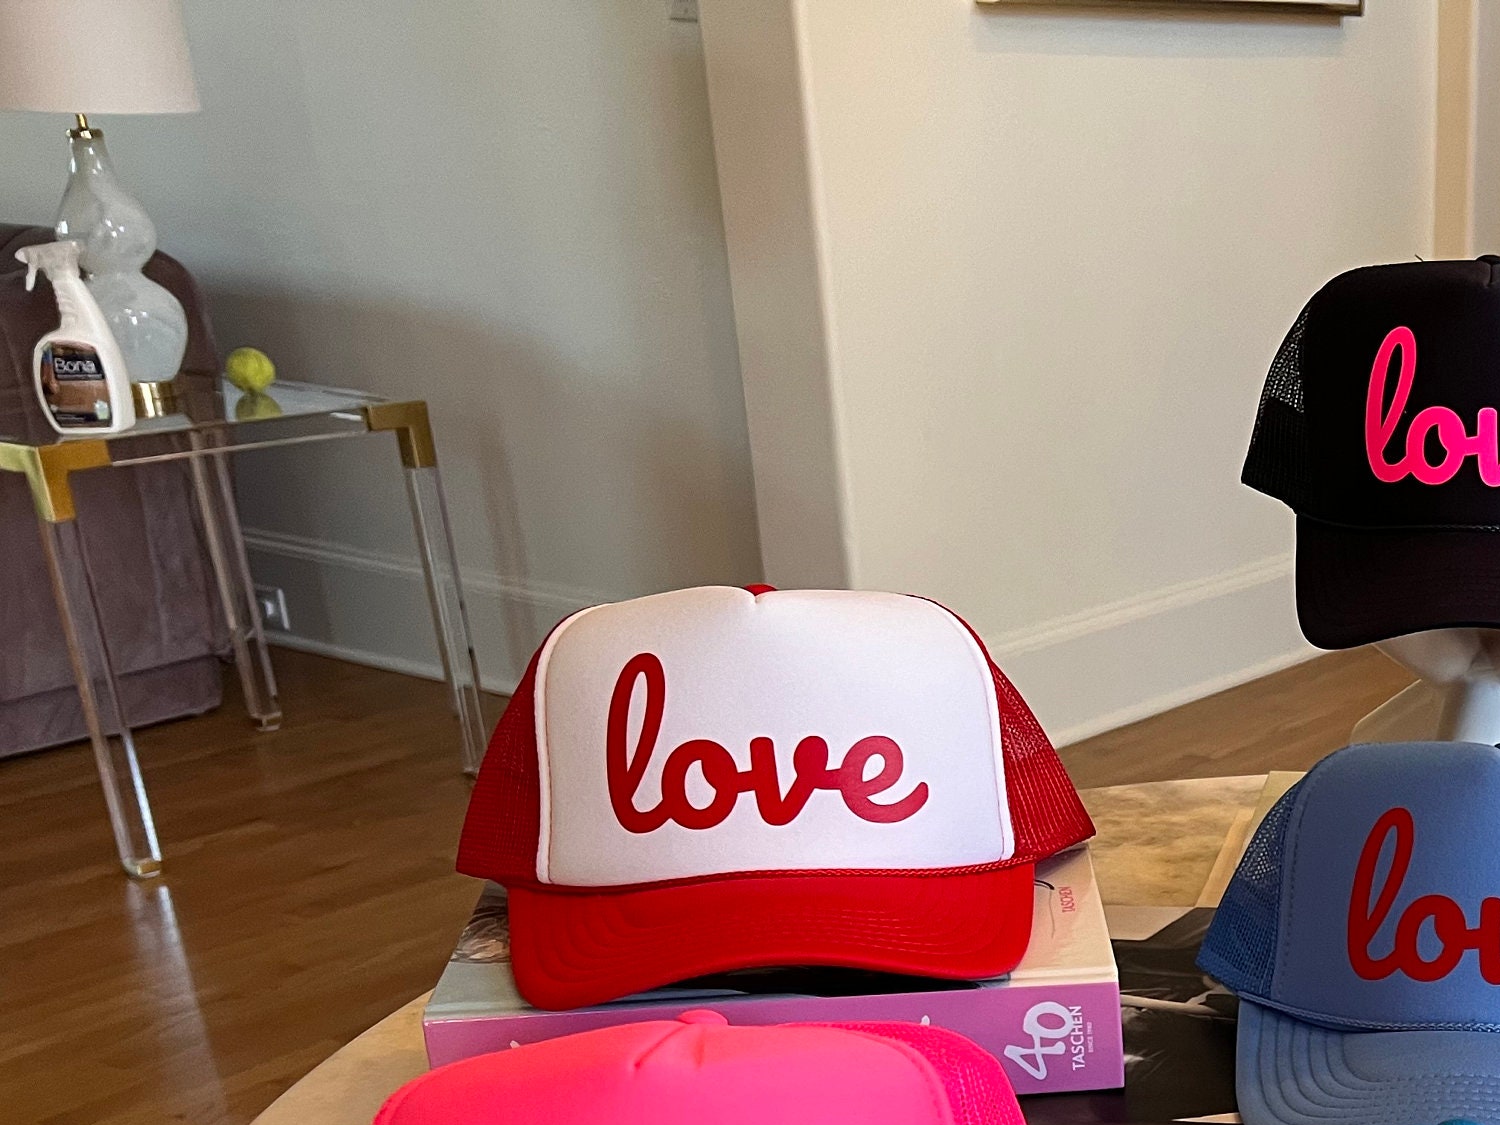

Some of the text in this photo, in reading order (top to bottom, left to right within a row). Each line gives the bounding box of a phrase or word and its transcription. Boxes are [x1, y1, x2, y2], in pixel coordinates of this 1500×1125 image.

[54, 357, 97, 374] Bona
[607, 652, 929, 834] love
[1068, 1005, 1085, 1071] TASCHEN
